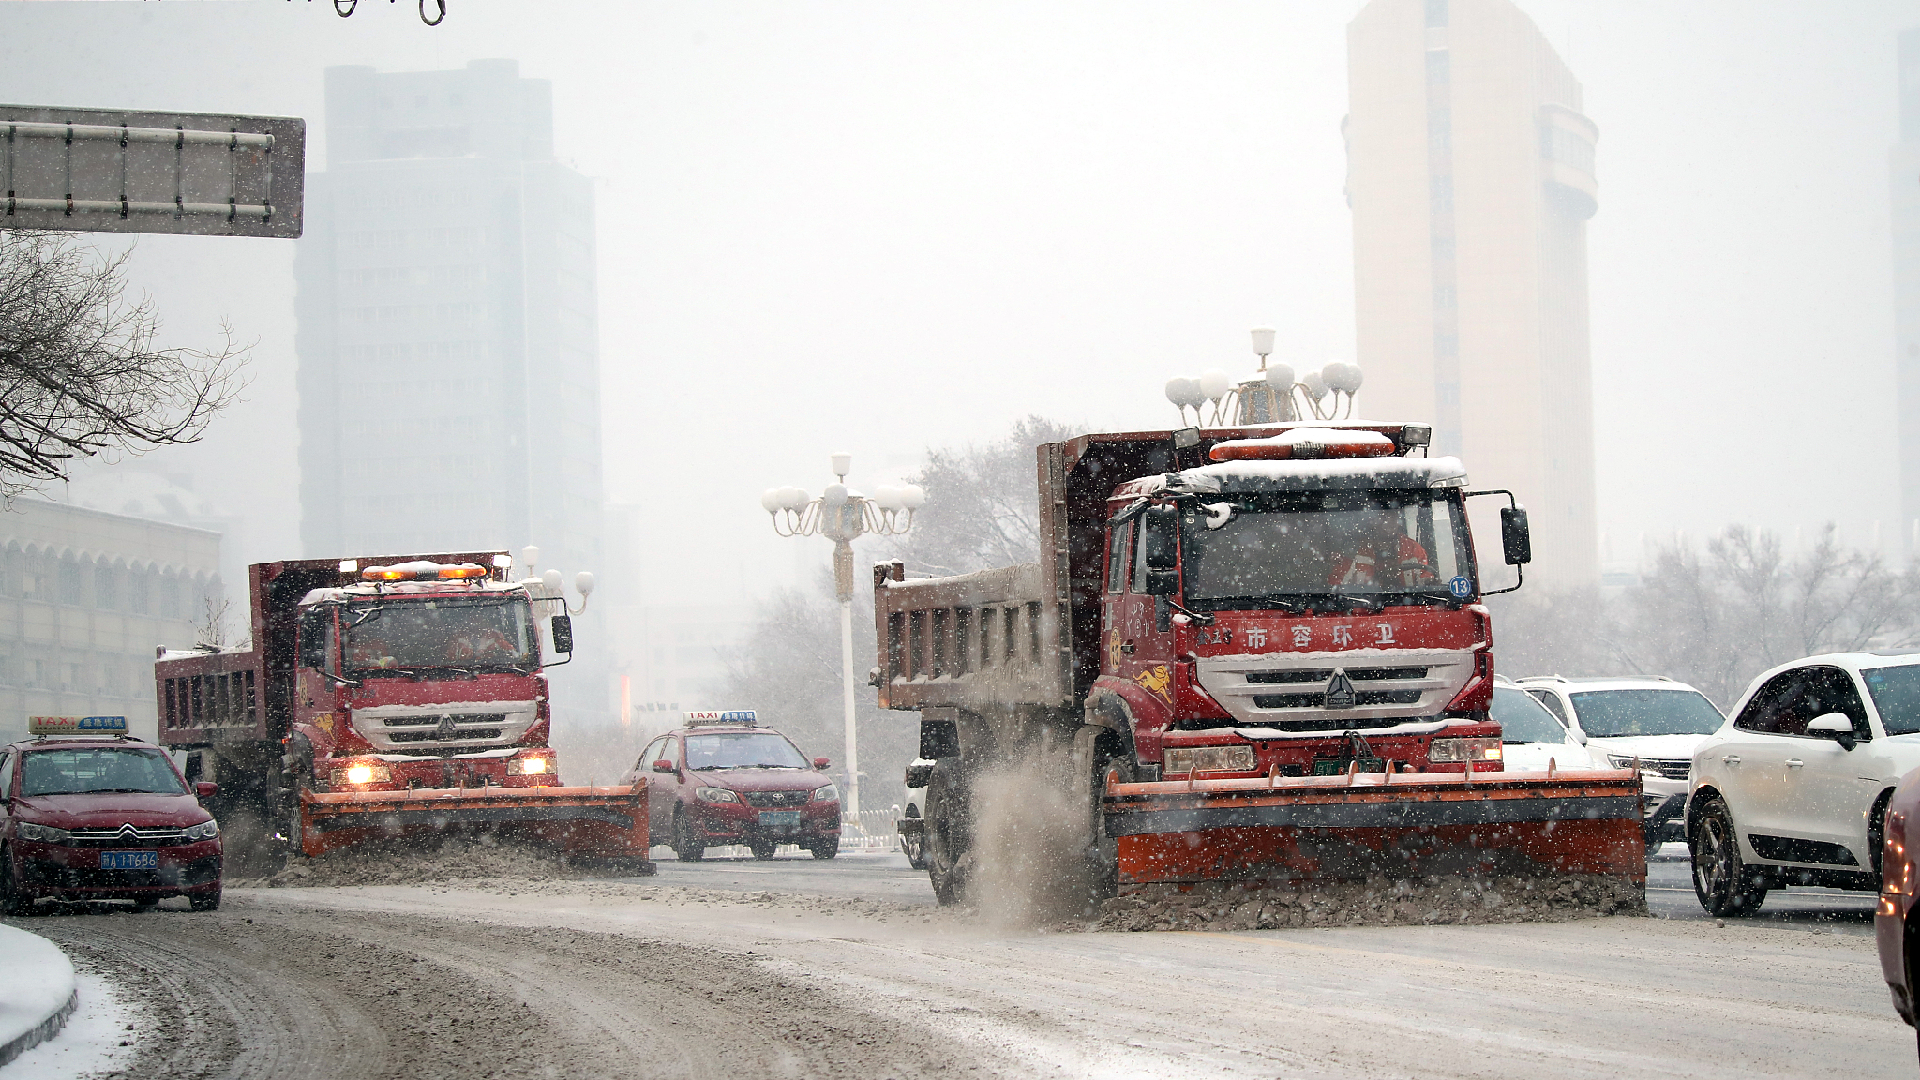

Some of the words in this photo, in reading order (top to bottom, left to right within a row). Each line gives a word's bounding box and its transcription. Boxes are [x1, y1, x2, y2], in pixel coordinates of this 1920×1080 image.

[1452, 580, 1468, 594] 13
[1246, 623, 1397, 649] 市容环卫
[35, 716, 76, 726] TAXI
